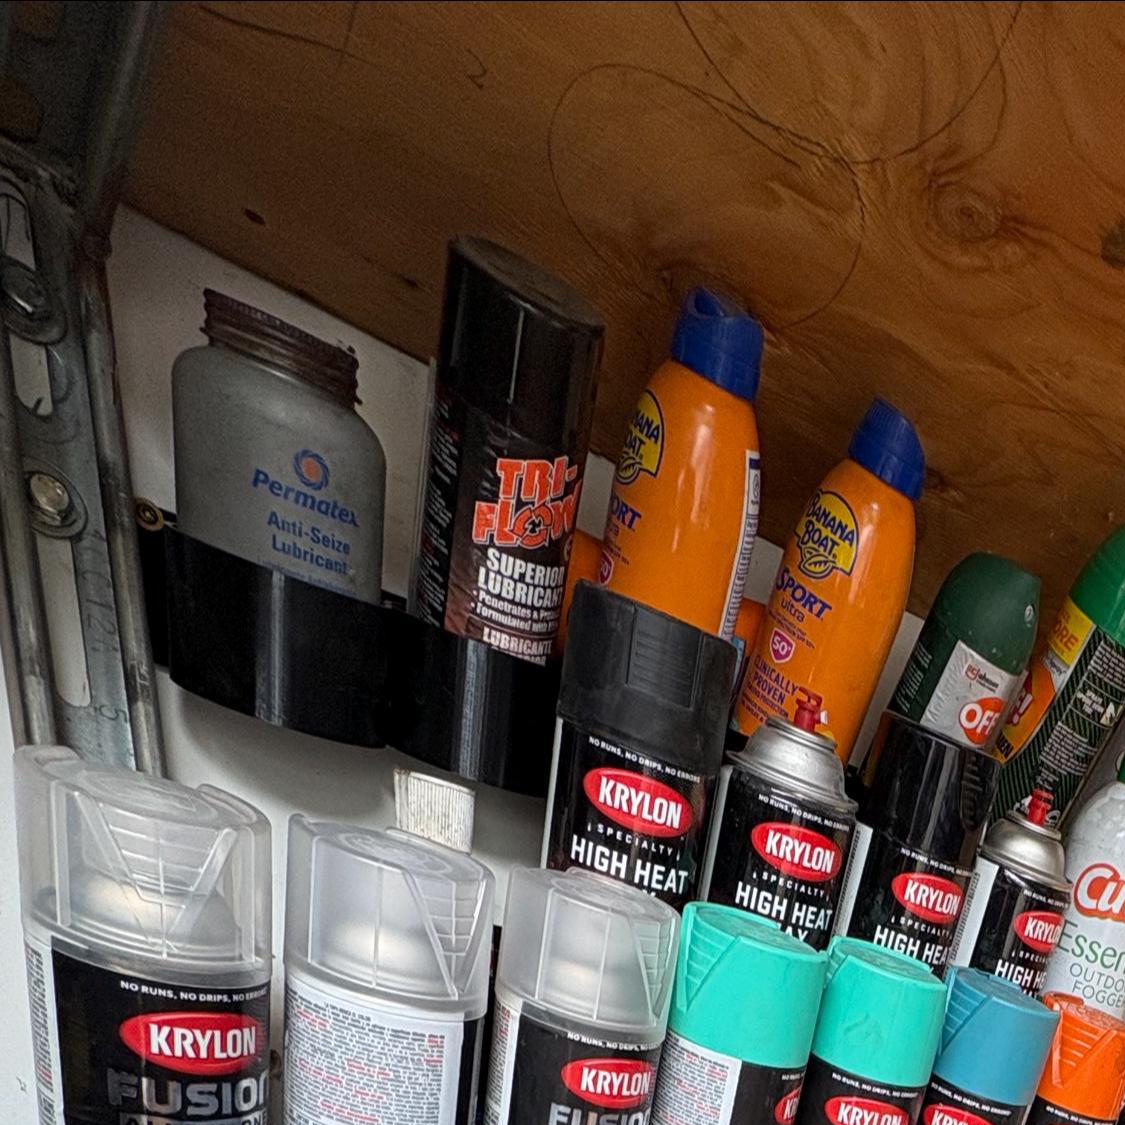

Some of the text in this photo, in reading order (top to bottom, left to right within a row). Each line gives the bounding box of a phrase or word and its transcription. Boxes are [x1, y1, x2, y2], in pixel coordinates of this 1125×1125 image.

[252, 468, 360, 528] Permatex
[267, 511, 351, 555] Anti-Seize
[804, 490, 857, 547] BANANA
[272, 534, 348, 576] Lubricant
[800, 520, 840, 558] BOAT
[478, 566, 563, 607] LUBRICANT
[487, 547, 565, 587] SUPERIOR
[775, 566, 832, 619] SPORT
[752, 671, 787, 706] PROVEN
[754, 654, 800, 695] CLINICALLY
[589, 736, 676, 776] NO RUNS, NO DRIPS, NO
[598, 777, 682, 829] KRYLON
[758, 793, 769, 804] NO
[597, 824, 673, 855] SPECIALTY
[766, 831, 835, 873] KRYLON
[570, 835, 688, 895] HIGH HEAT
[762, 871, 826, 898] SPECIALTY
[735, 881, 833, 931] HIGH HEAT
[904, 880, 961, 916] KRYLON
[873, 925, 920, 960] HIGH
[120, 980, 245, 1003] NO RUNS, NO DRIPS, NO
[995, 959, 1033, 988] HIGH
[149, 1024, 256, 1060] KRYLON
[567, 1031, 580, 1042] NO
[580, 1067, 650, 1094] KRYLON
